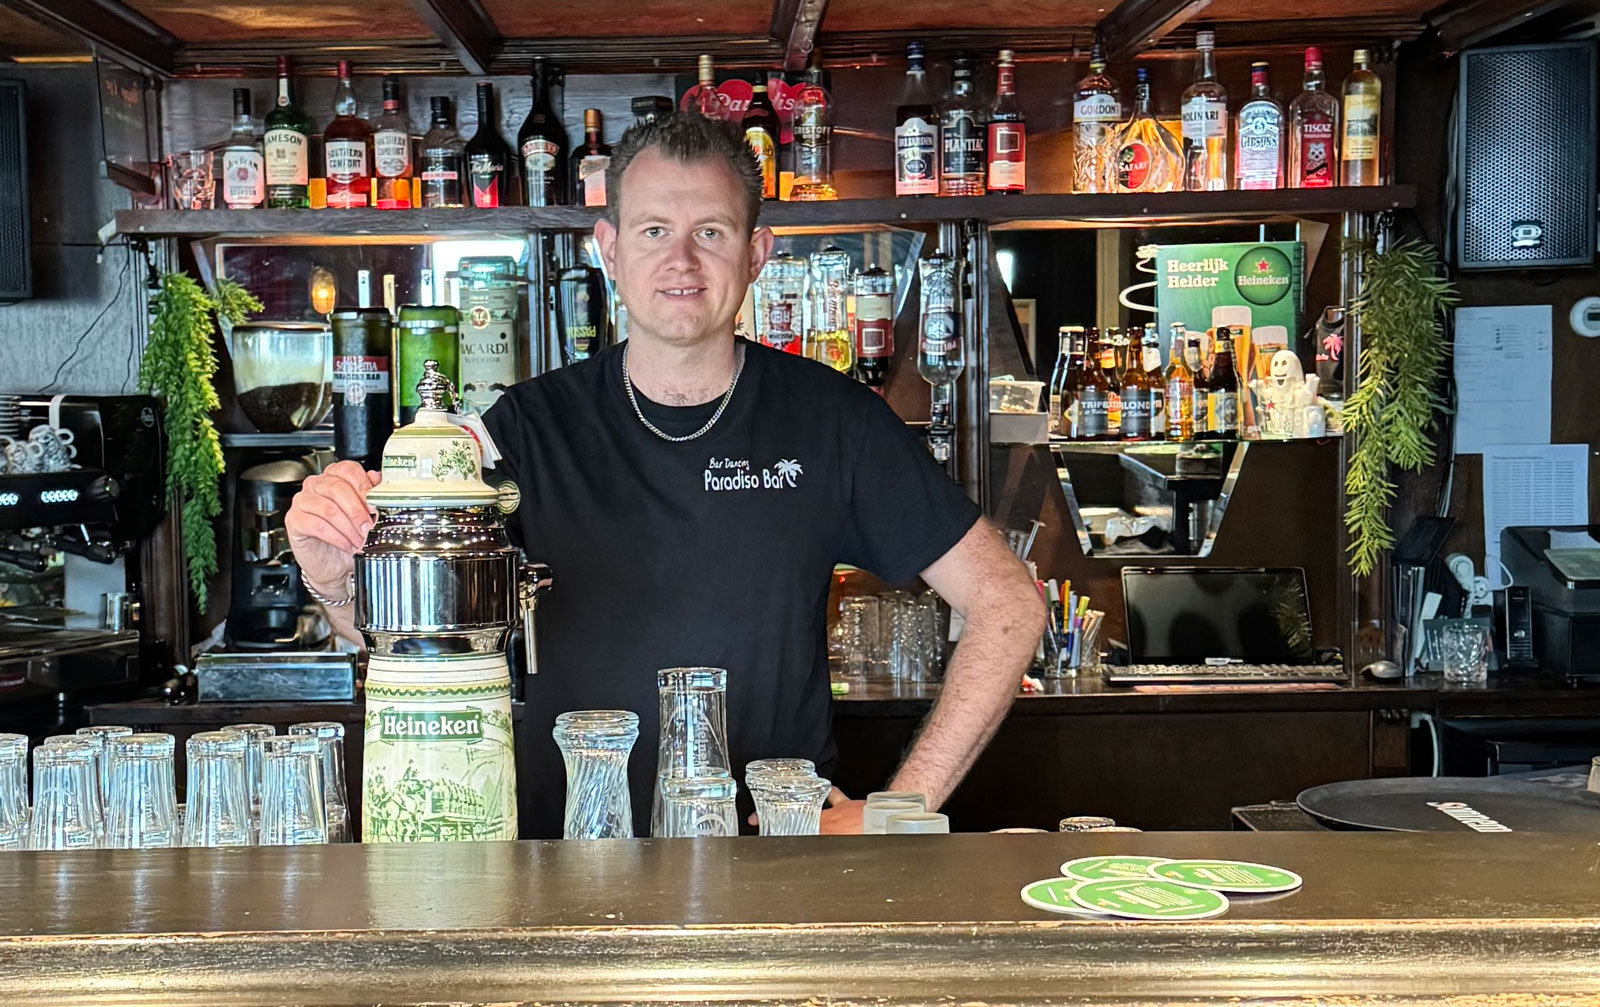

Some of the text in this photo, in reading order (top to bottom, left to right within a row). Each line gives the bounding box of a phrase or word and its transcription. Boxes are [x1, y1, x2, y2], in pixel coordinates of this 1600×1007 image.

[1303, 124, 1332, 133] TISCAZ
[266, 134, 303, 146] JAMESON
[328, 147, 363, 159] SOUTHERN
[329, 159, 362, 169] COMFORT
[1119, 161, 1147, 173] SAFARI
[1167, 258, 1228, 274] Heerlijk
[1167, 275, 1219, 288] Helder
[1237, 275, 1289, 286] Heineken
[709, 457, 750, 470] Bar Dancing
[704, 468, 784, 491] Paradiso Bar
[383, 715, 480, 736] Heineken
